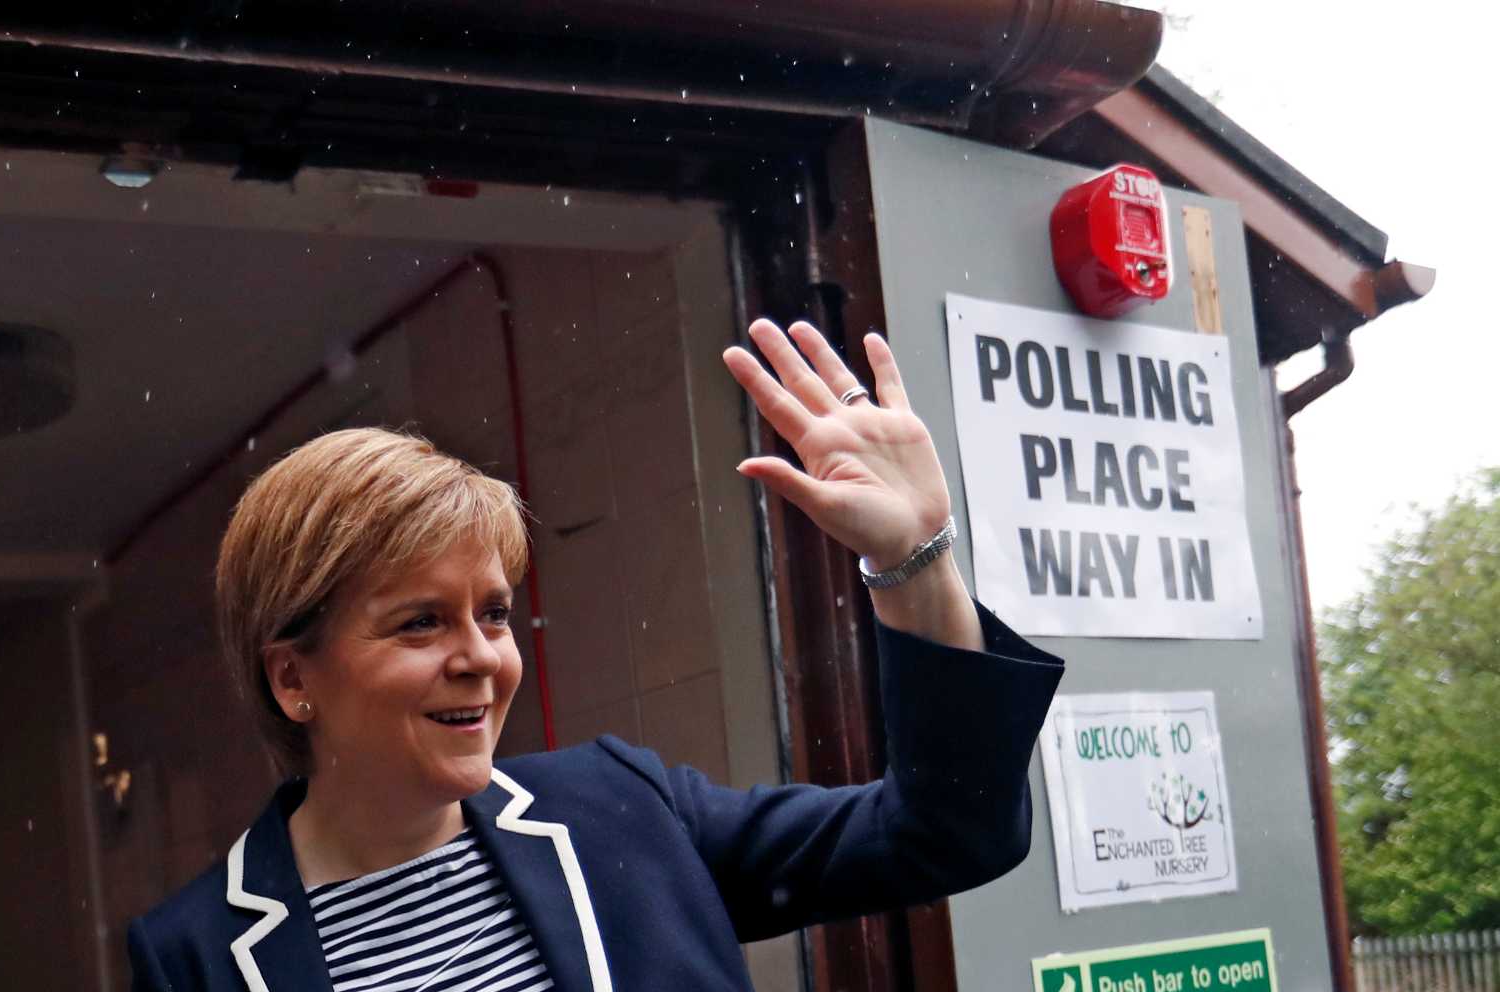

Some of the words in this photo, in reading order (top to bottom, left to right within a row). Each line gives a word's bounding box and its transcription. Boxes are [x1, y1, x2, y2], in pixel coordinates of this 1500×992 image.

[1114, 171, 1158, 197] STOP
[975, 334, 1214, 426] POLLING
[1019, 433, 1196, 513] PLACE
[1018, 527, 1141, 599] WAY
[1158, 536, 1215, 602] IN
[1074, 725, 1161, 760] WELCOME
[1093, 830, 1174, 861] ENCHANTED
[1154, 856, 1209, 877] NURSERY
[1191, 964, 1211, 988] to
[1218, 960, 1264, 988] open
